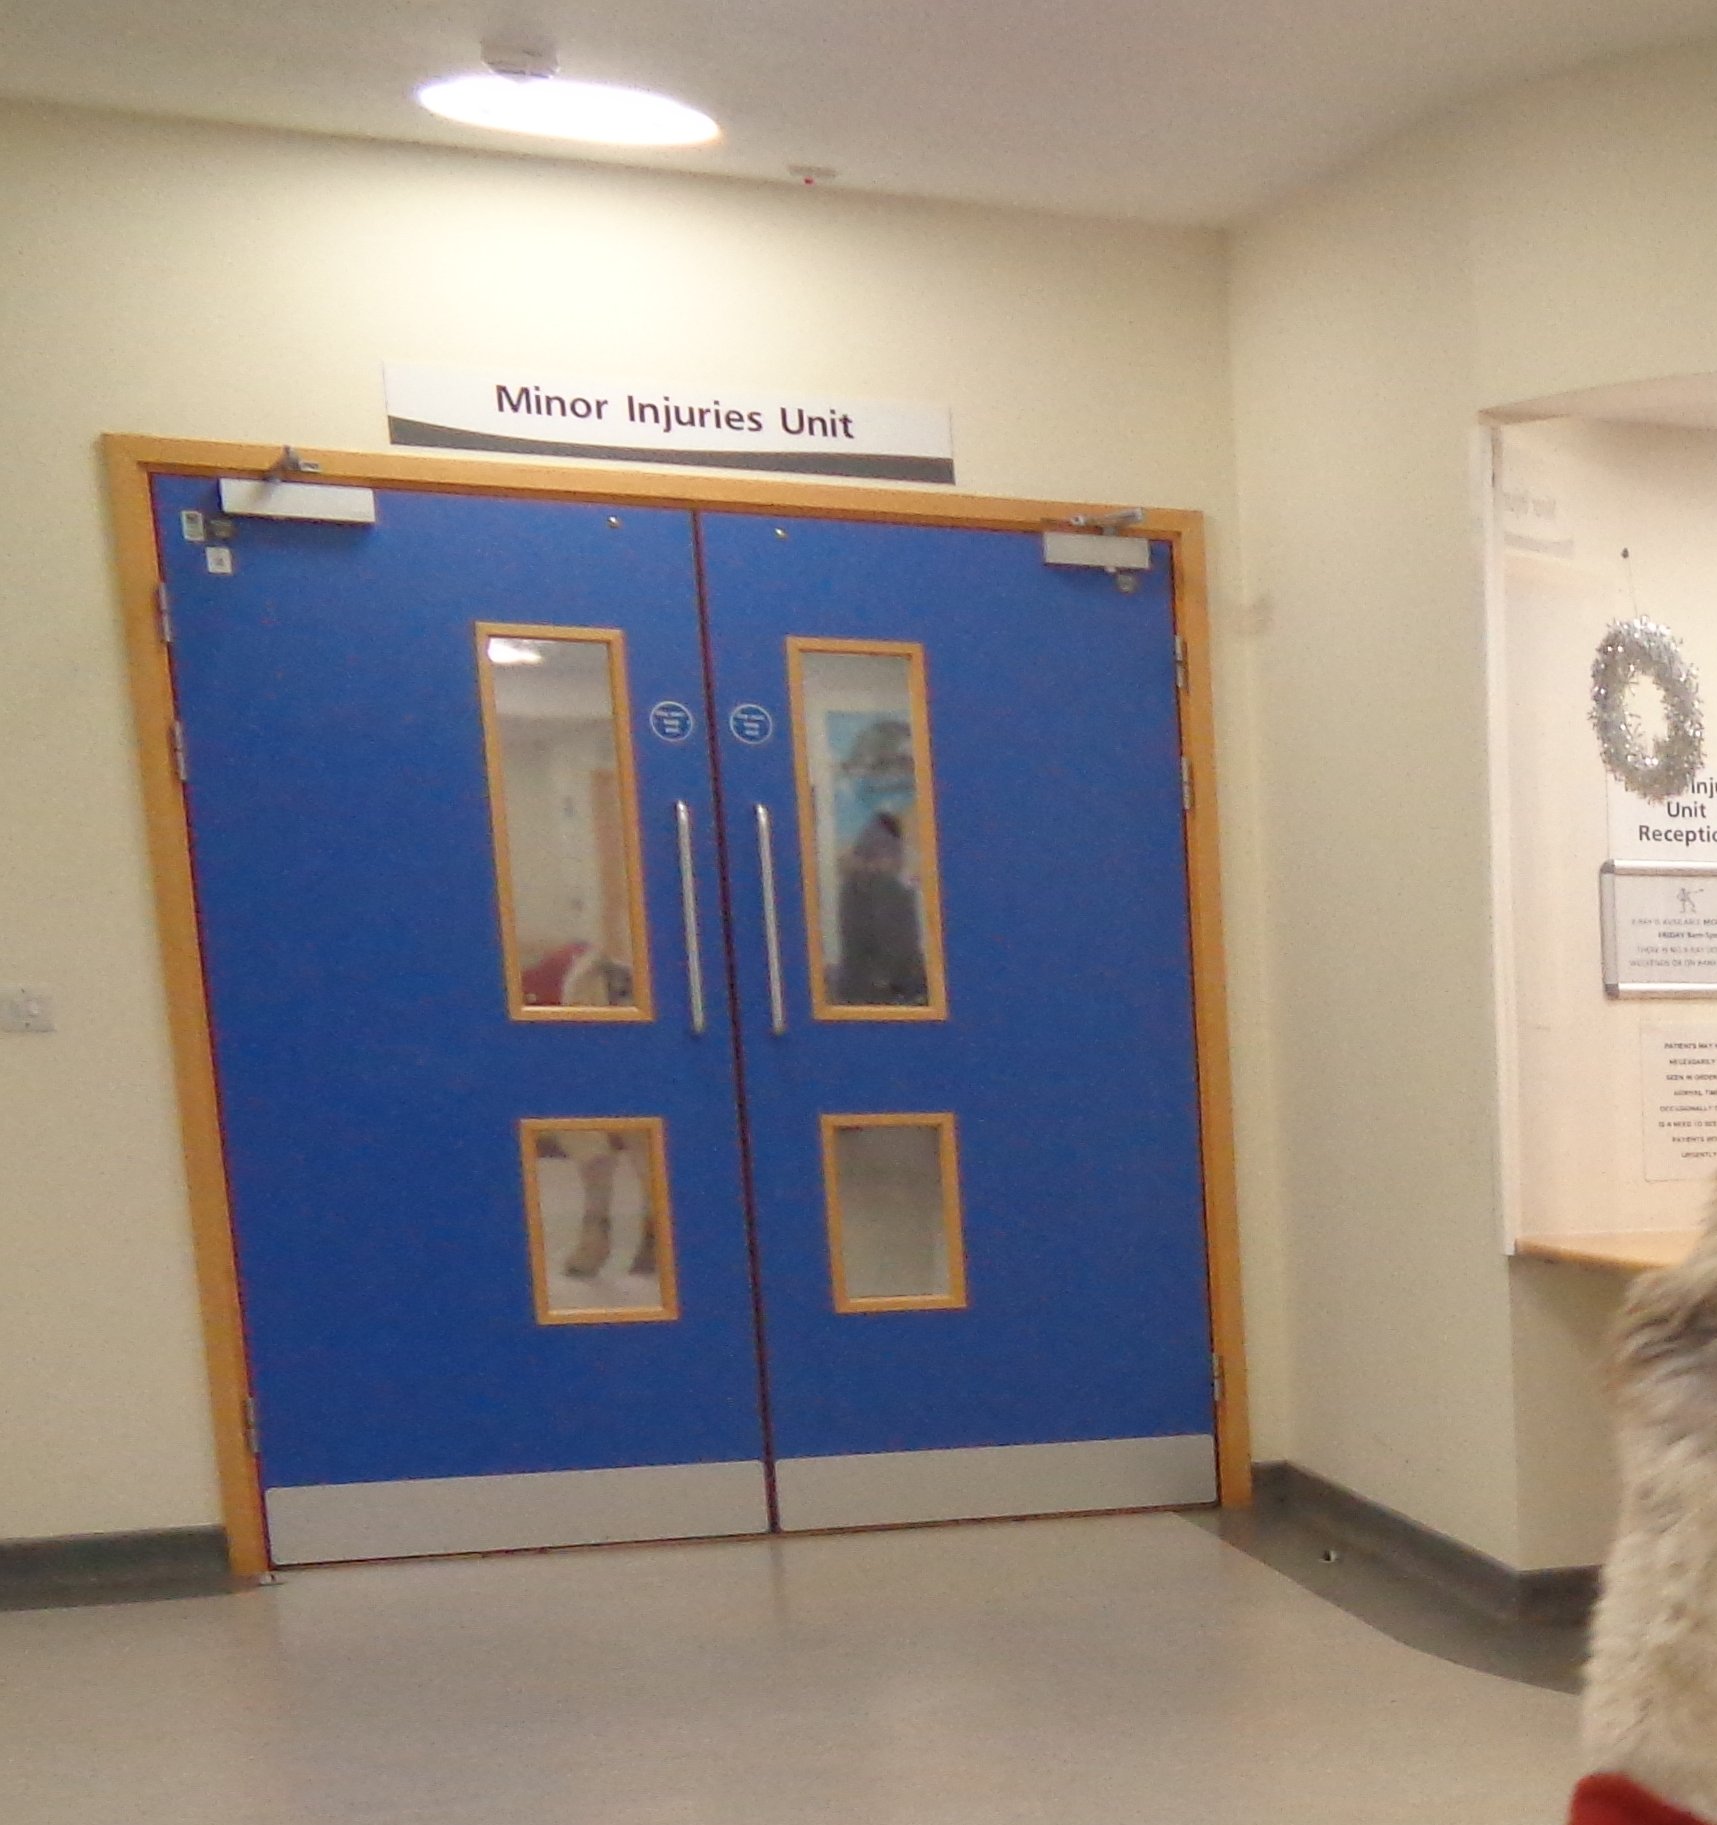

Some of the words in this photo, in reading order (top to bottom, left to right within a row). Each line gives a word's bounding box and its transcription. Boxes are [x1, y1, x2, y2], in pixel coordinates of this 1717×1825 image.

[495, 384, 610, 421] Minor
[627, 393, 763, 434] Injuries
[780, 406, 855, 440] Unit
[1667, 801, 1707, 818] Unit
